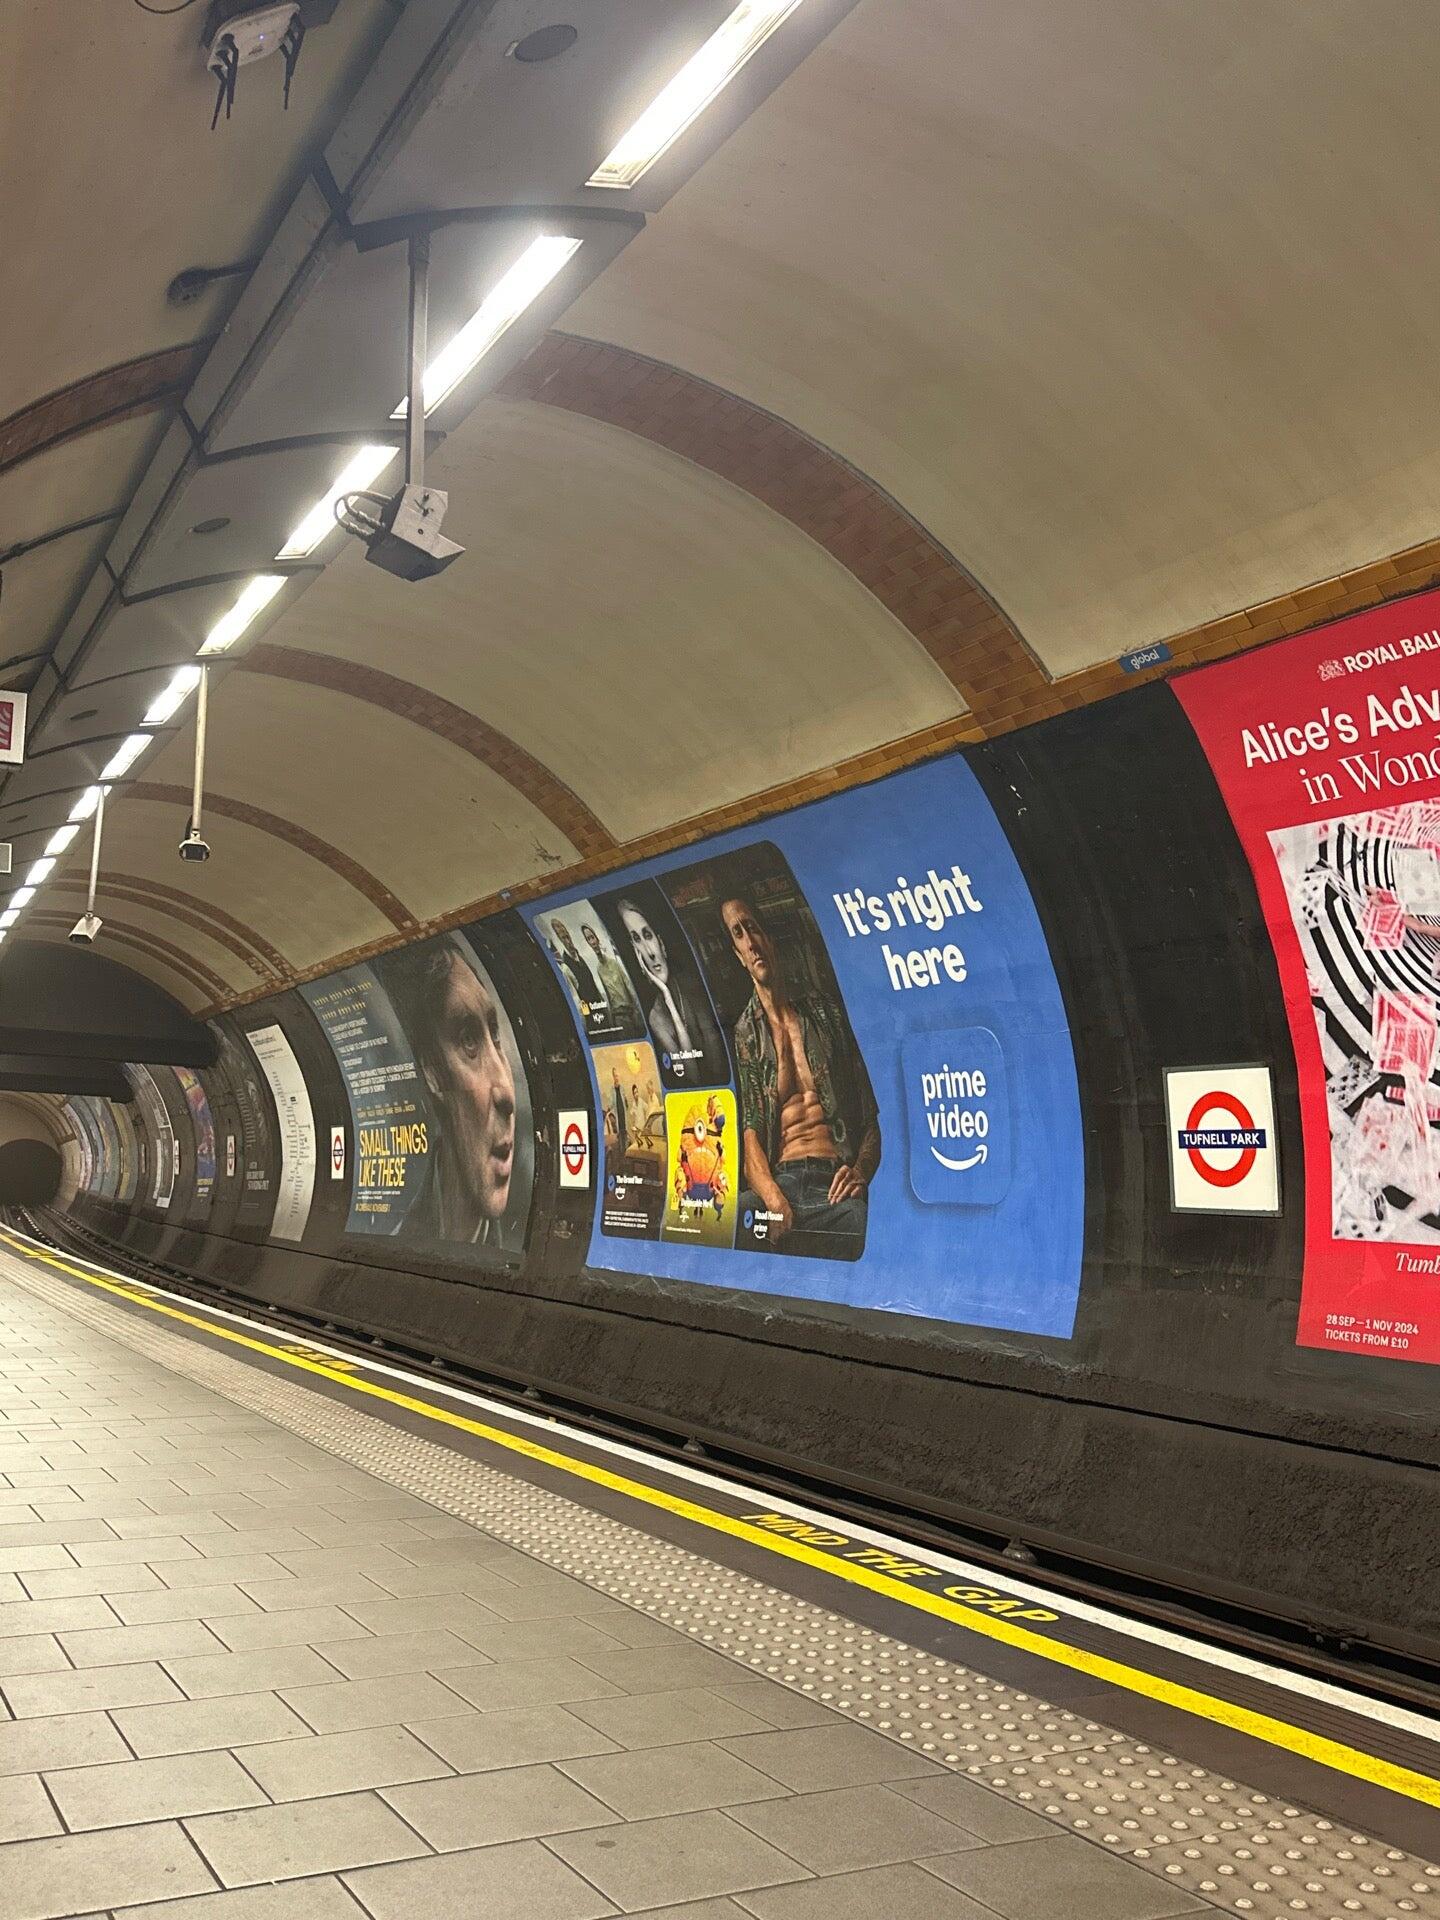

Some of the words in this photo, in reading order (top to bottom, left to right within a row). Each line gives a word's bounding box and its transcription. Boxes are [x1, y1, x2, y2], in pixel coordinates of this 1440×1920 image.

[1130, 649, 1160, 670] global
[1343, 643, 1402, 674] ROYAL
[1241, 707, 1359, 768] Alice's
[1299, 768, 1343, 805] in
[833, 888, 891, 937] It's
[887, 866, 983, 931] right
[881, 944, 967, 991] here
[921, 1063, 986, 1107] prime
[926, 1103, 989, 1138] video
[360, 1128, 390, 1157] SMALL
[390, 1123, 428, 1155] THINGS
[1183, 1133, 1228, 1145] TUFNELL
[1230, 1133, 1260, 1145] PARK
[359, 1159, 376, 1187] LIKE
[377, 1157, 406, 1187] THESE
[754, 1223, 767, 1233] prime
[1325, 1328, 1361, 1343] TICKETS
[1362, 1334, 1389, 1346] FROM
[1391, 1337, 1409, 1349] £10
[1326, 1314, 1337, 1325] 28
[1338, 1315, 1355, 1326] SEP
[1365, 1319, 1371, 1329] 1
[1373, 1320, 1392, 1331] NOV
[1394, 1322, 1419, 1335] 2024
[741, 1513, 849, 1546] MIND
[844, 1549, 942, 1578] THE
[944, 1586, 1060, 1622] GAP
